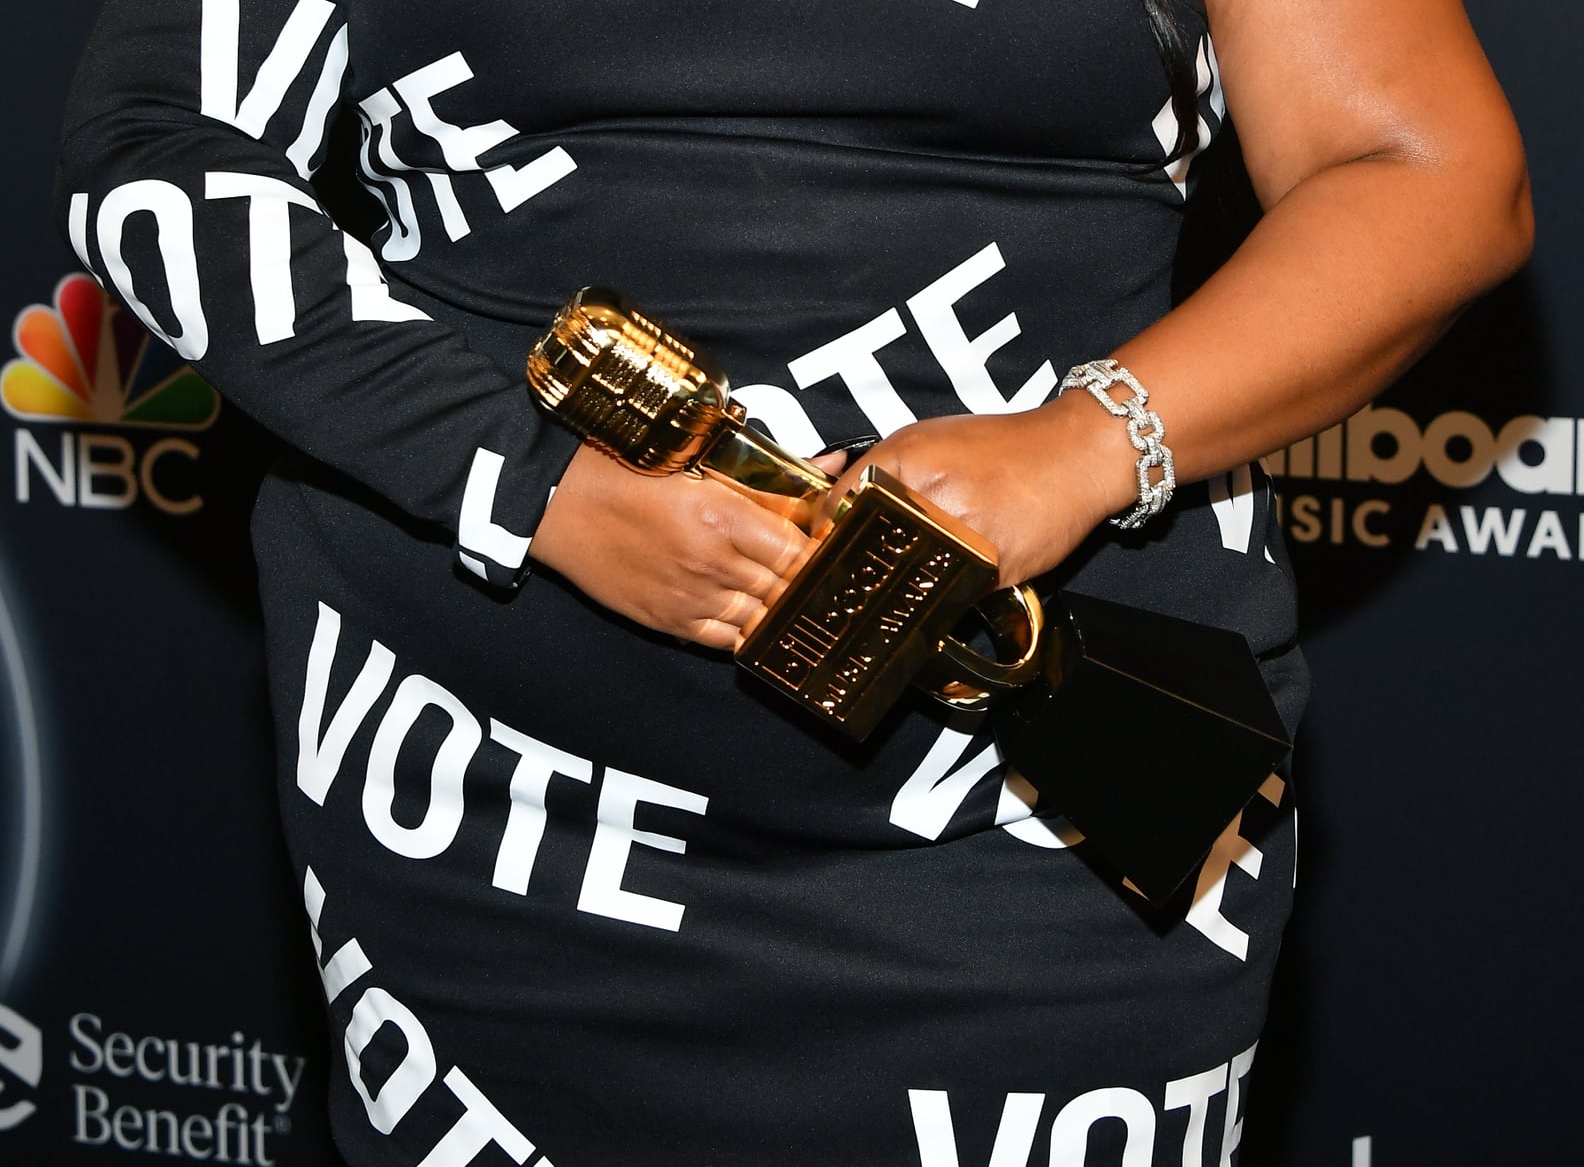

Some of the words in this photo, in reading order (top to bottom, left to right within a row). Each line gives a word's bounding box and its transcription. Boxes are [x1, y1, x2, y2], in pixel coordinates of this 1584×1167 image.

[15, 429, 204, 515] NBC
[1277, 493, 1391, 548] SIC
[1414, 502, 1584, 562] AWA
[296, 600, 709, 932] VOTE
[69, 1012, 307, 1112] Security
[304, 865, 556, 1167] VOT
